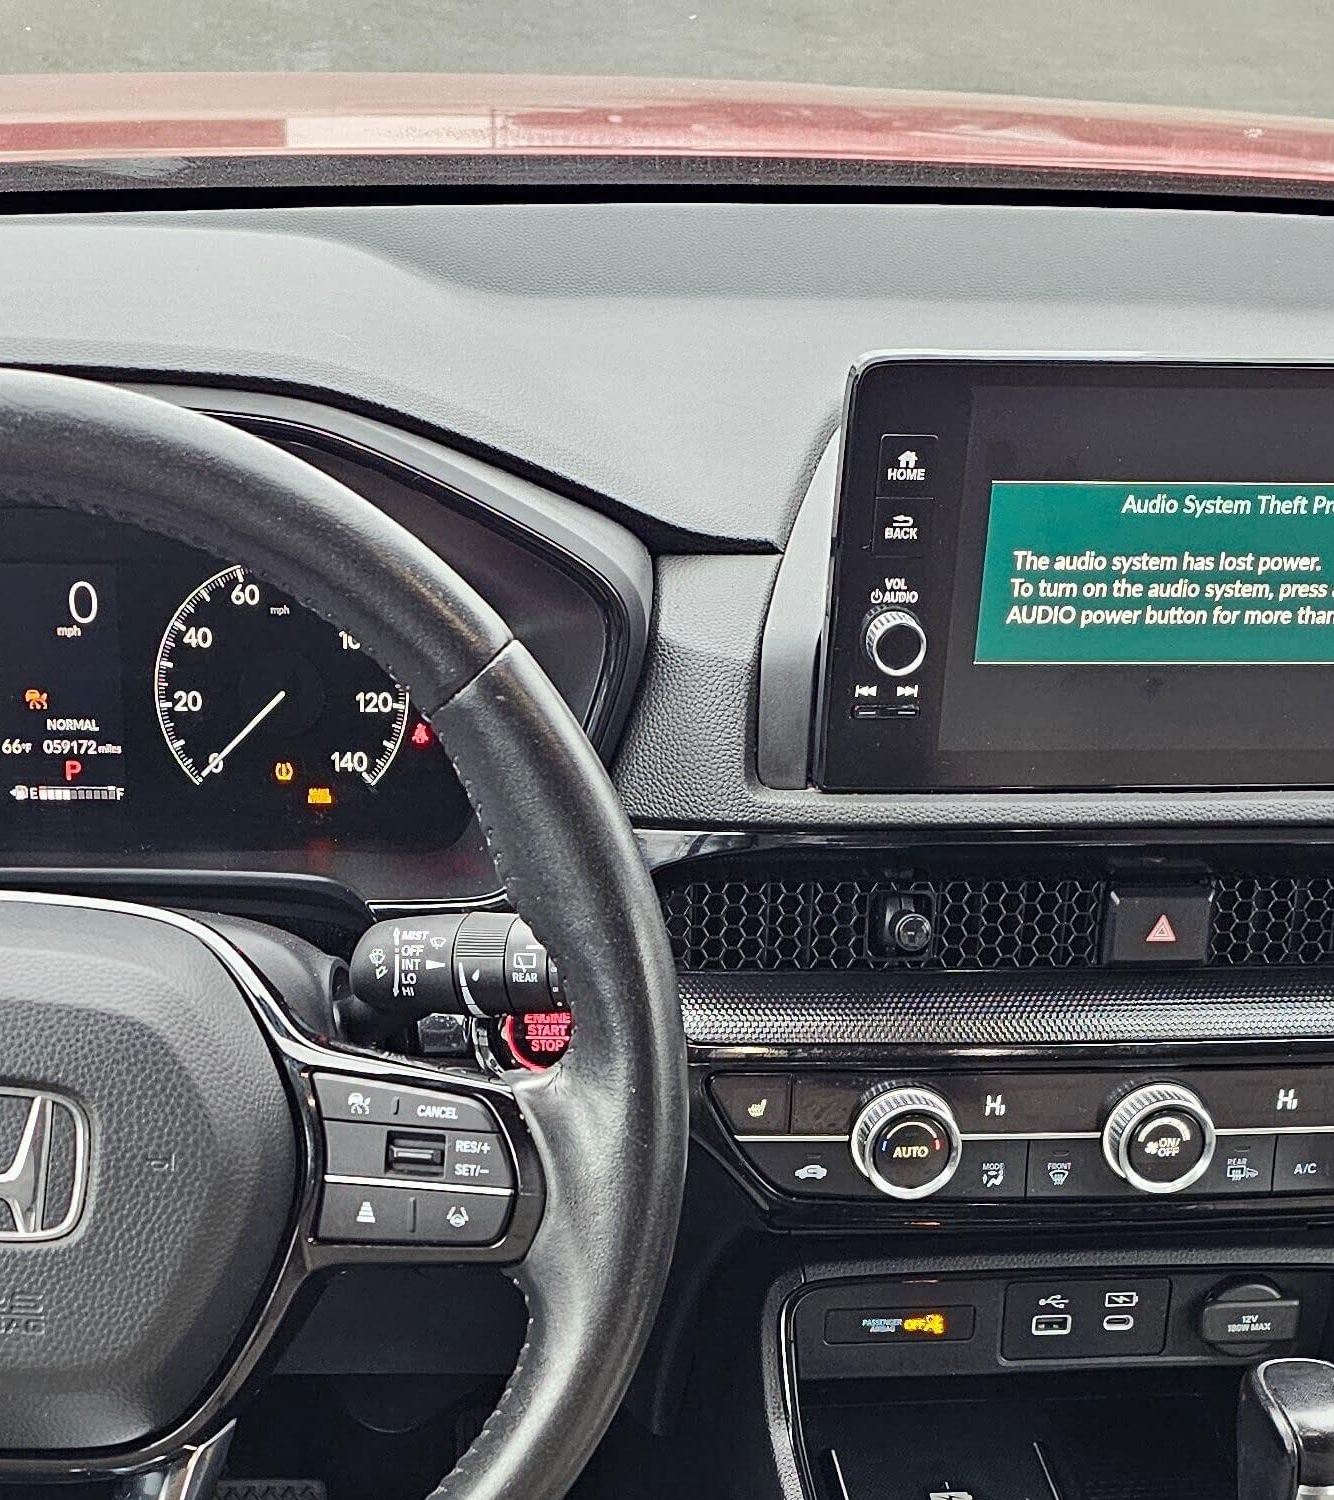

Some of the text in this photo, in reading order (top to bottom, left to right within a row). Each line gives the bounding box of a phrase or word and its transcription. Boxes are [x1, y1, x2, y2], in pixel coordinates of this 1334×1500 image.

[887, 468, 926, 481] HOME
[1121, 494, 1178, 514] Audio
[1182, 495, 1251, 518] System
[1257, 495, 1308, 514] Theft
[884, 527, 918, 540] BACK
[1013, 551, 1322, 575] The audio system has lost power.
[884, 578, 908, 591] VOL
[1011, 578, 1033, 598] To
[1038, 580, 1078, 598] turn
[1082, 583, 1107, 598] on
[1112, 579, 1144, 598] the
[1147, 578, 1201, 598] audio
[1205, 580, 1274, 601] system,
[1279, 583, 1328, 602] press
[231, 584, 260, 606] 60
[882, 591, 919, 604] AUDIO
[68, 581, 98, 624] 0
[270, 604, 290, 616] mph
[1006, 605, 1076, 625] AUDIO
[1080, 608, 1142, 628] power
[1145, 605, 1208, 625] button
[1212, 605, 1241, 625] for
[1244, 609, 1292, 625] more
[57, 625, 82, 638] mph
[183, 627, 212, 649] 40
[173, 691, 202, 712] 20
[356, 692, 393, 713] 120
[46, 719, 99, 731] NORMAL
[43, 739, 97, 755] 059172
[331, 752, 368, 772] 140
[67, 761, 81, 780] P
[30, 788, 38, 800] E
[117, 788, 124, 800] F
[401, 930, 430, 941] MIST
[401, 945, 424, 956] OFF
[401, 959, 420, 971] INT
[401, 973, 417, 984] LO
[512, 972, 538, 983] REAR
[402, 986, 415, 996] HI
[524, 1012, 572, 1024] ENGINE
[527, 1025, 568, 1036] START
[531, 1039, 564, 1052] STOP
[417, 1105, 458, 1120] CANCEL
[893, 1146, 929, 1158] AUTO
[1157, 1147, 1180, 1157] OFF
[1047, 1162, 1071, 1170] FRONT
[1294, 1163, 1317, 1175] A/C
